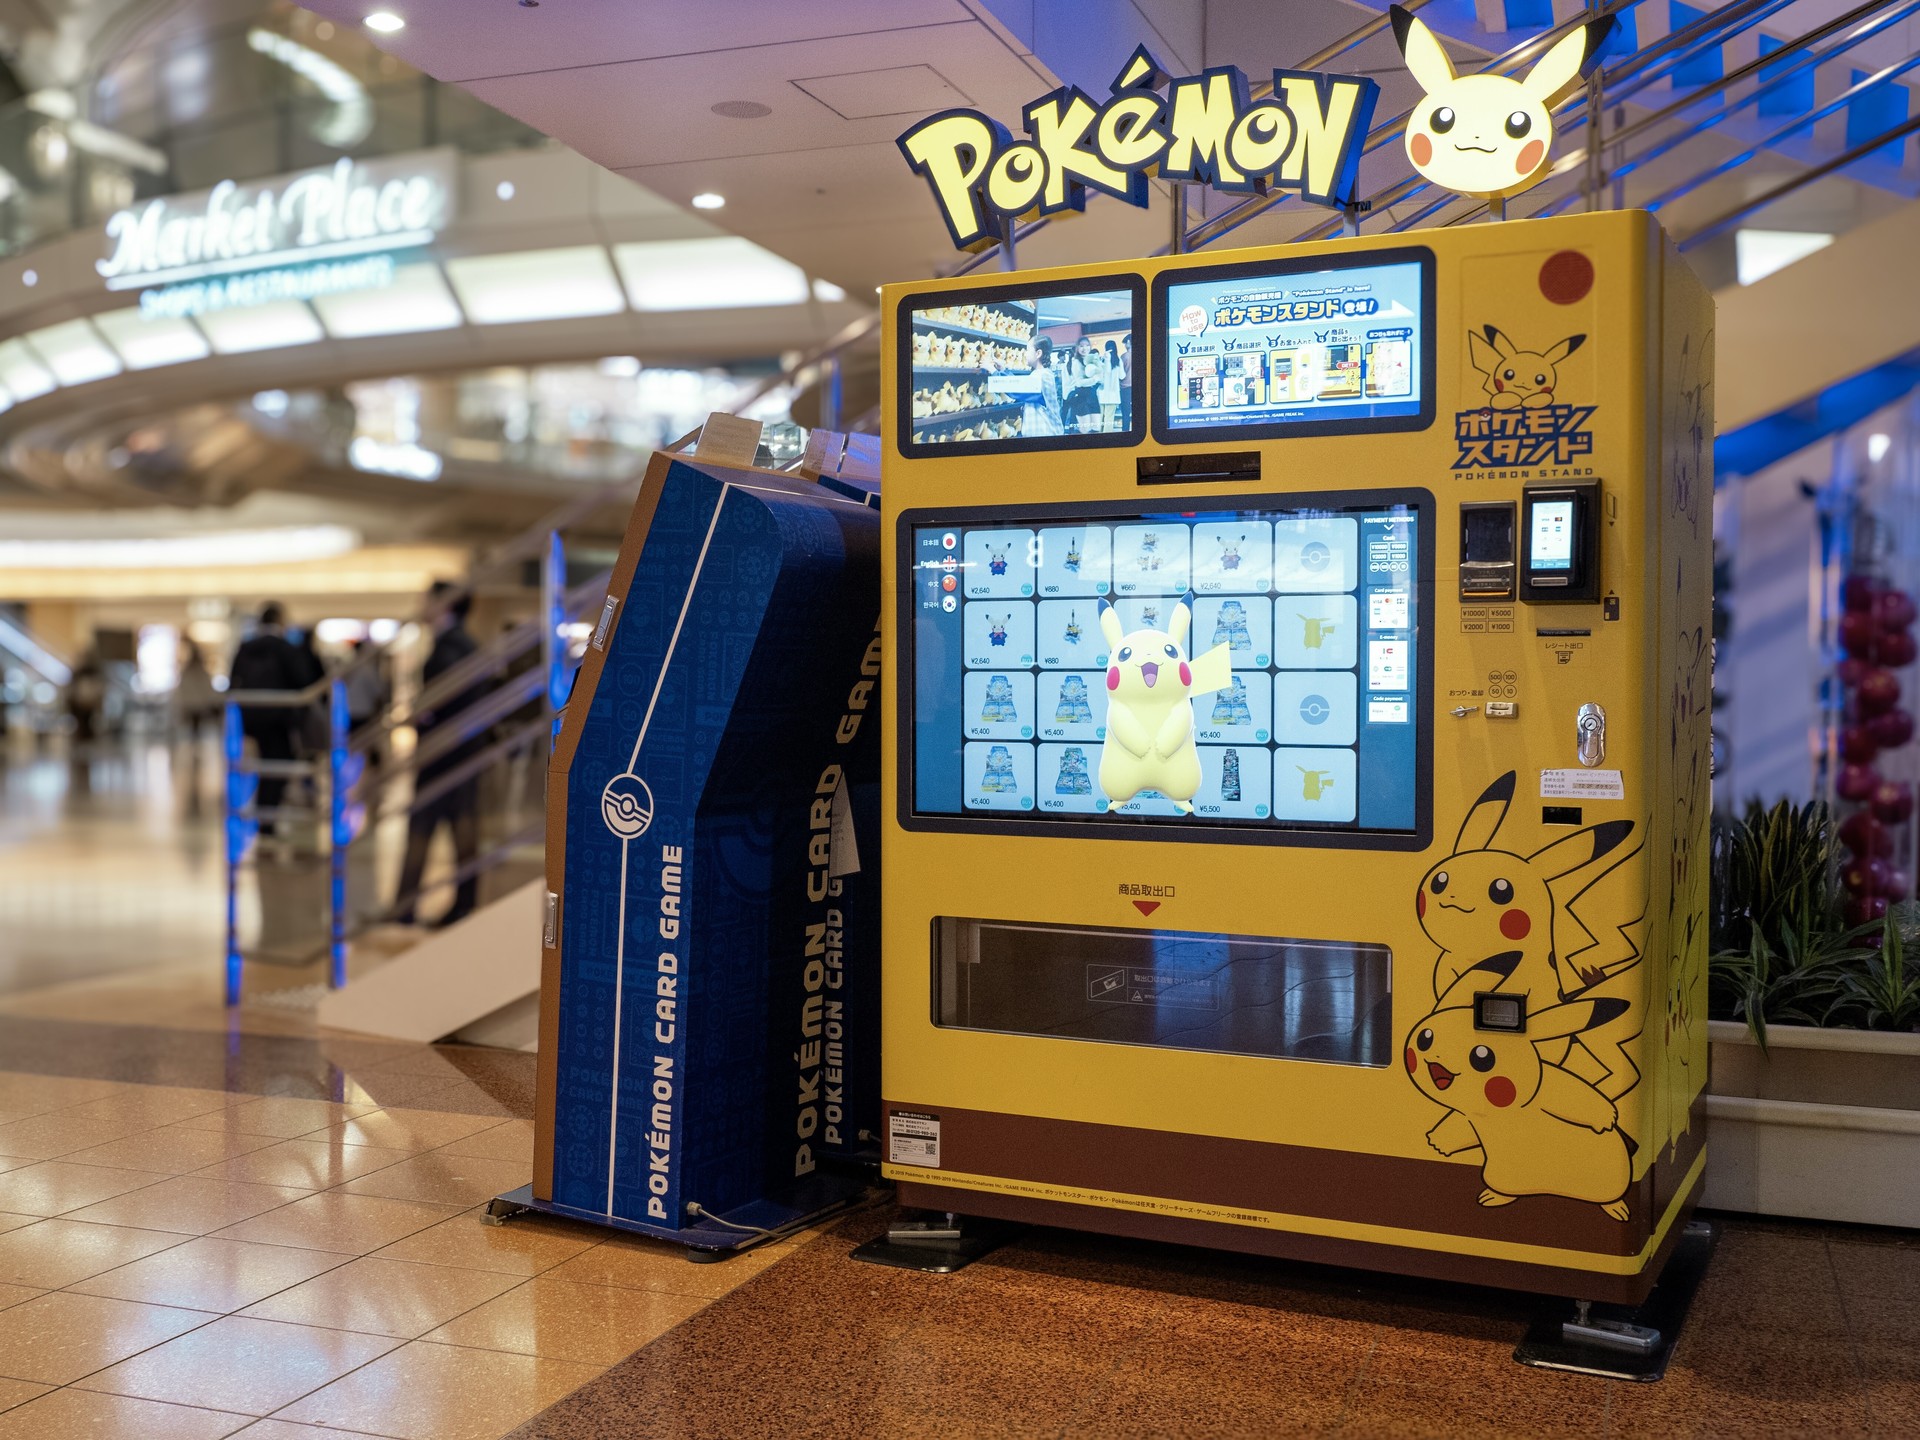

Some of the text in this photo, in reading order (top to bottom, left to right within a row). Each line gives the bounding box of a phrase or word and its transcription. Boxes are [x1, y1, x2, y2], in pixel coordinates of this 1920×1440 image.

[95, 156, 431, 277] Market Place
[1182, 309, 1202, 322] How
[1190, 318, 1199, 326] to
[1187, 323, 1204, 334] use
[1457, 406, 1593, 439] ポケモン
[1455, 434, 1590, 468] スタンド
[1455, 468, 1593, 480] POKÉMON STAND
[923, 538, 939, 546] 日本語
[920, 560, 940, 568] English
[928, 580, 939, 588] 中文
[923, 601, 939, 609] 한국어
[1463, 609, 1511, 617] ¥10000 ¥5000
[1045, 728, 1064, 736] ¥5,400
[1200, 731, 1220, 739] ¥5,400
[971, 797, 990, 805] ¥5,400
[1044, 800, 1064, 808] ¥5,400
[1200, 805, 1220, 813] ¥5,500
[807, 764, 843, 903] CARD
[659, 844, 682, 940] GAME
[1118, 883, 1175, 897] 商品取出口
[825, 908, 843, 990] CARD
[655, 951, 678, 1044] CARD
[794, 922, 827, 1178] POKÉMON
[820, 999, 843, 1146] POKÉMON
[645, 1055, 674, 1220] POKÉMON
